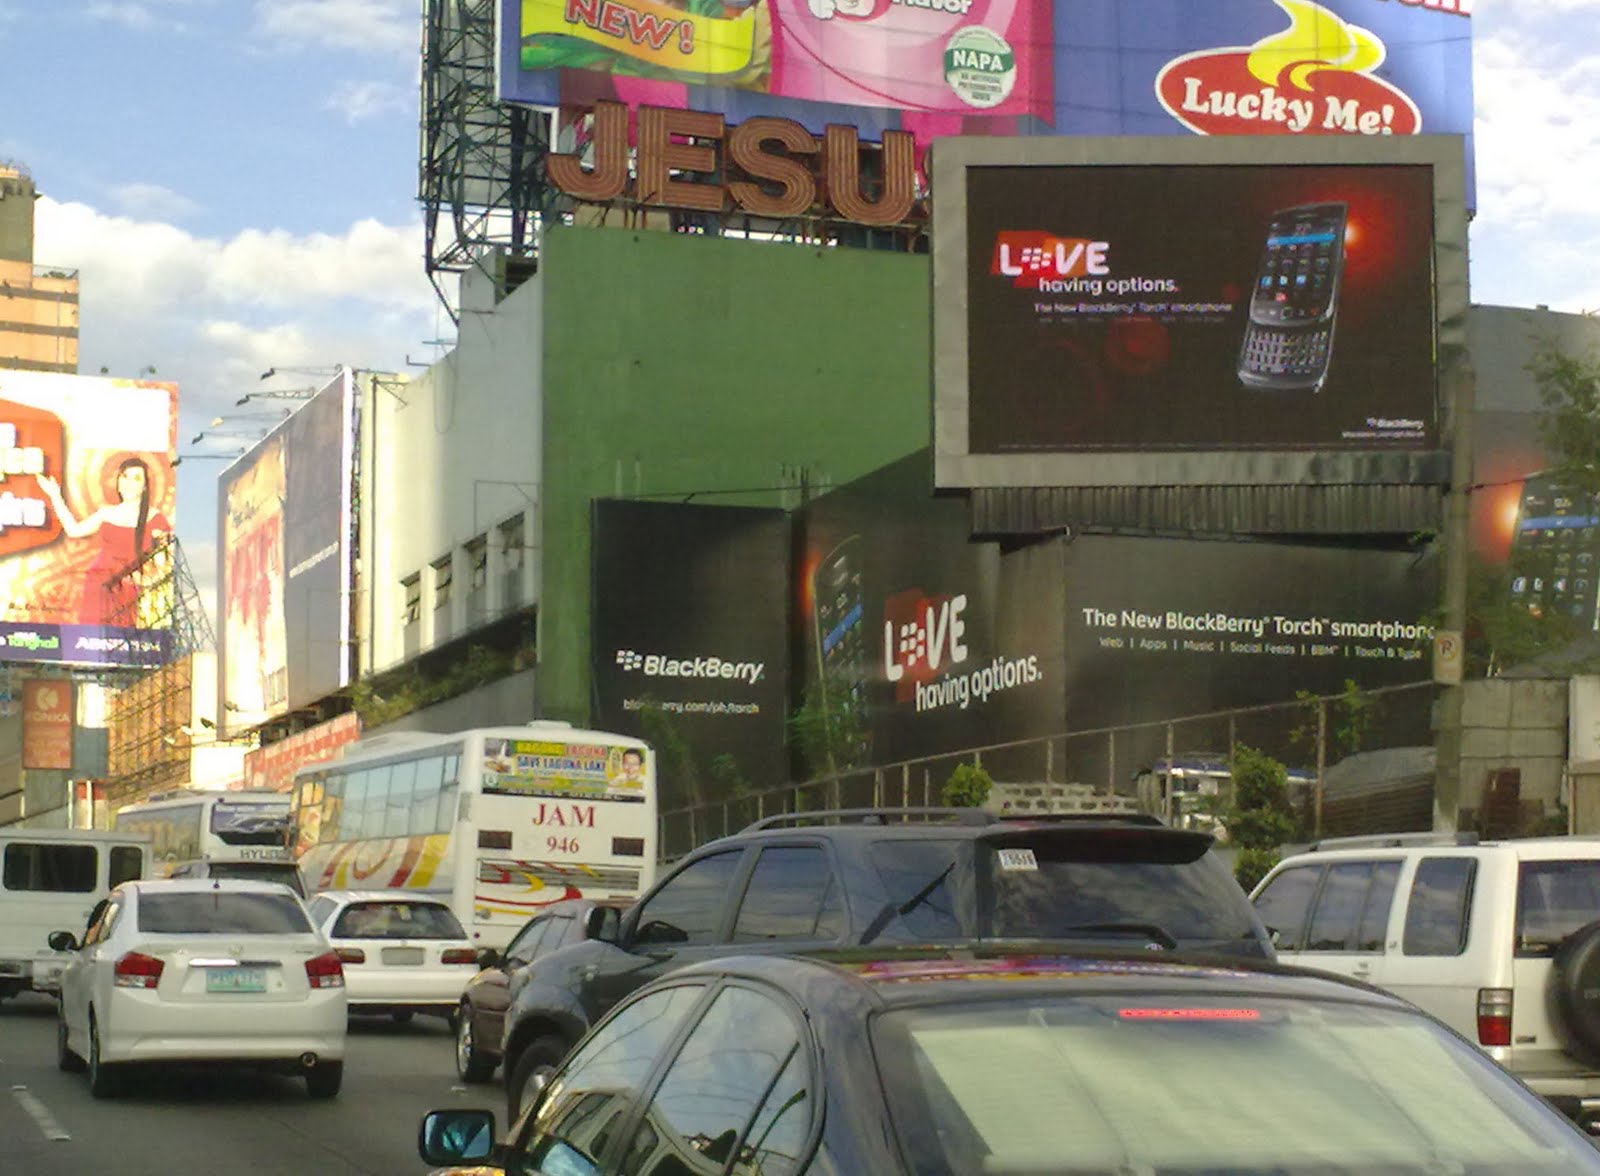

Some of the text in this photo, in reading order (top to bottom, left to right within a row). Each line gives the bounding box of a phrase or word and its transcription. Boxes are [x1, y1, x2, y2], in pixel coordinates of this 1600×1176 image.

[953, 50, 1004, 71] NAPA
[1181, 77, 1395, 135] Lucky Me!
[546, 103, 932, 226] JESU
[1038, 277, 1102, 296] having
[1083, 608, 1117, 627] The
[1121, 610, 1162, 629] New
[1139, 638, 1168, 651] Apps
[1183, 640, 1215, 652] Music
[916, 653, 1042, 712] having options.
[533, 803, 596, 828] JAM
[547, 837, 579, 854] 946
